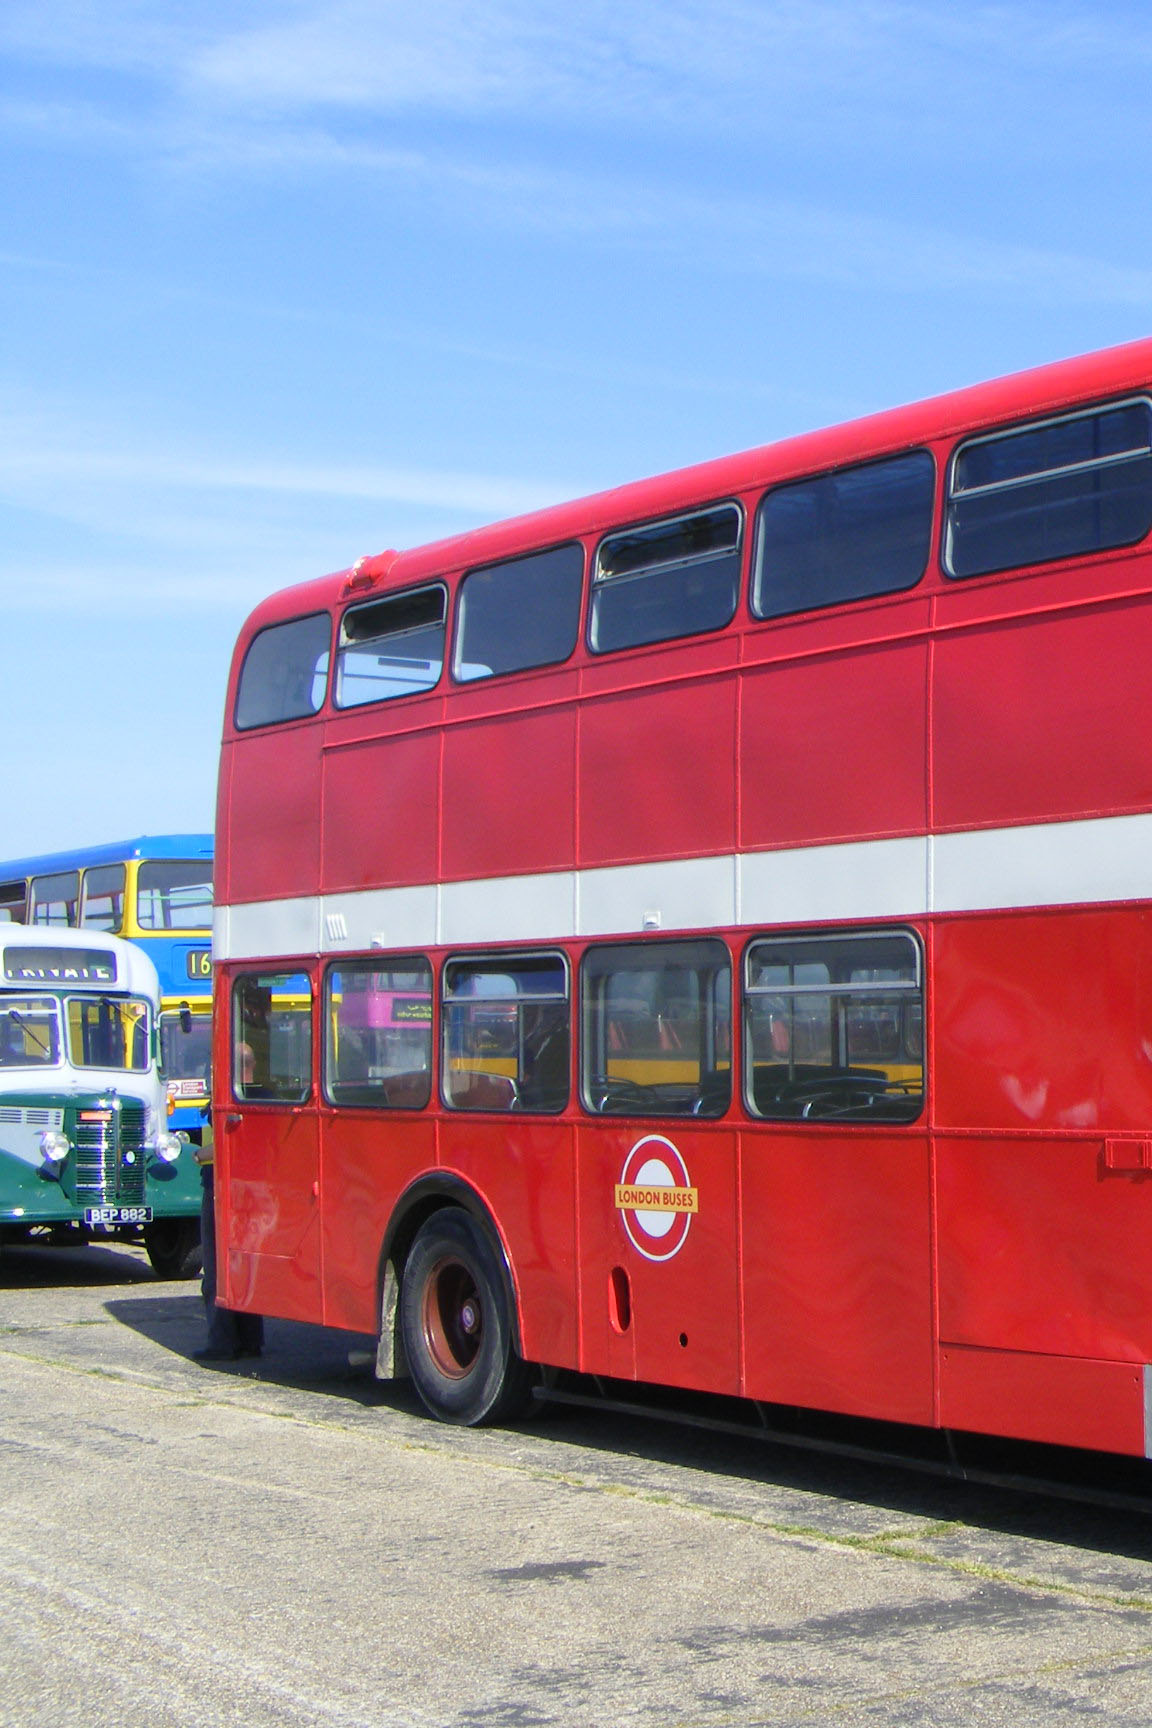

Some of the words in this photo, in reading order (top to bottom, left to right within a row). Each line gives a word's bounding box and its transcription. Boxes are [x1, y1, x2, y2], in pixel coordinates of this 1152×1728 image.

[618, 1190, 660, 1205] LONDON
[662, 1191, 693, 1207] BUSES
[91, 1208, 118, 1221] BEP
[121, 1208, 147, 1220] 882
